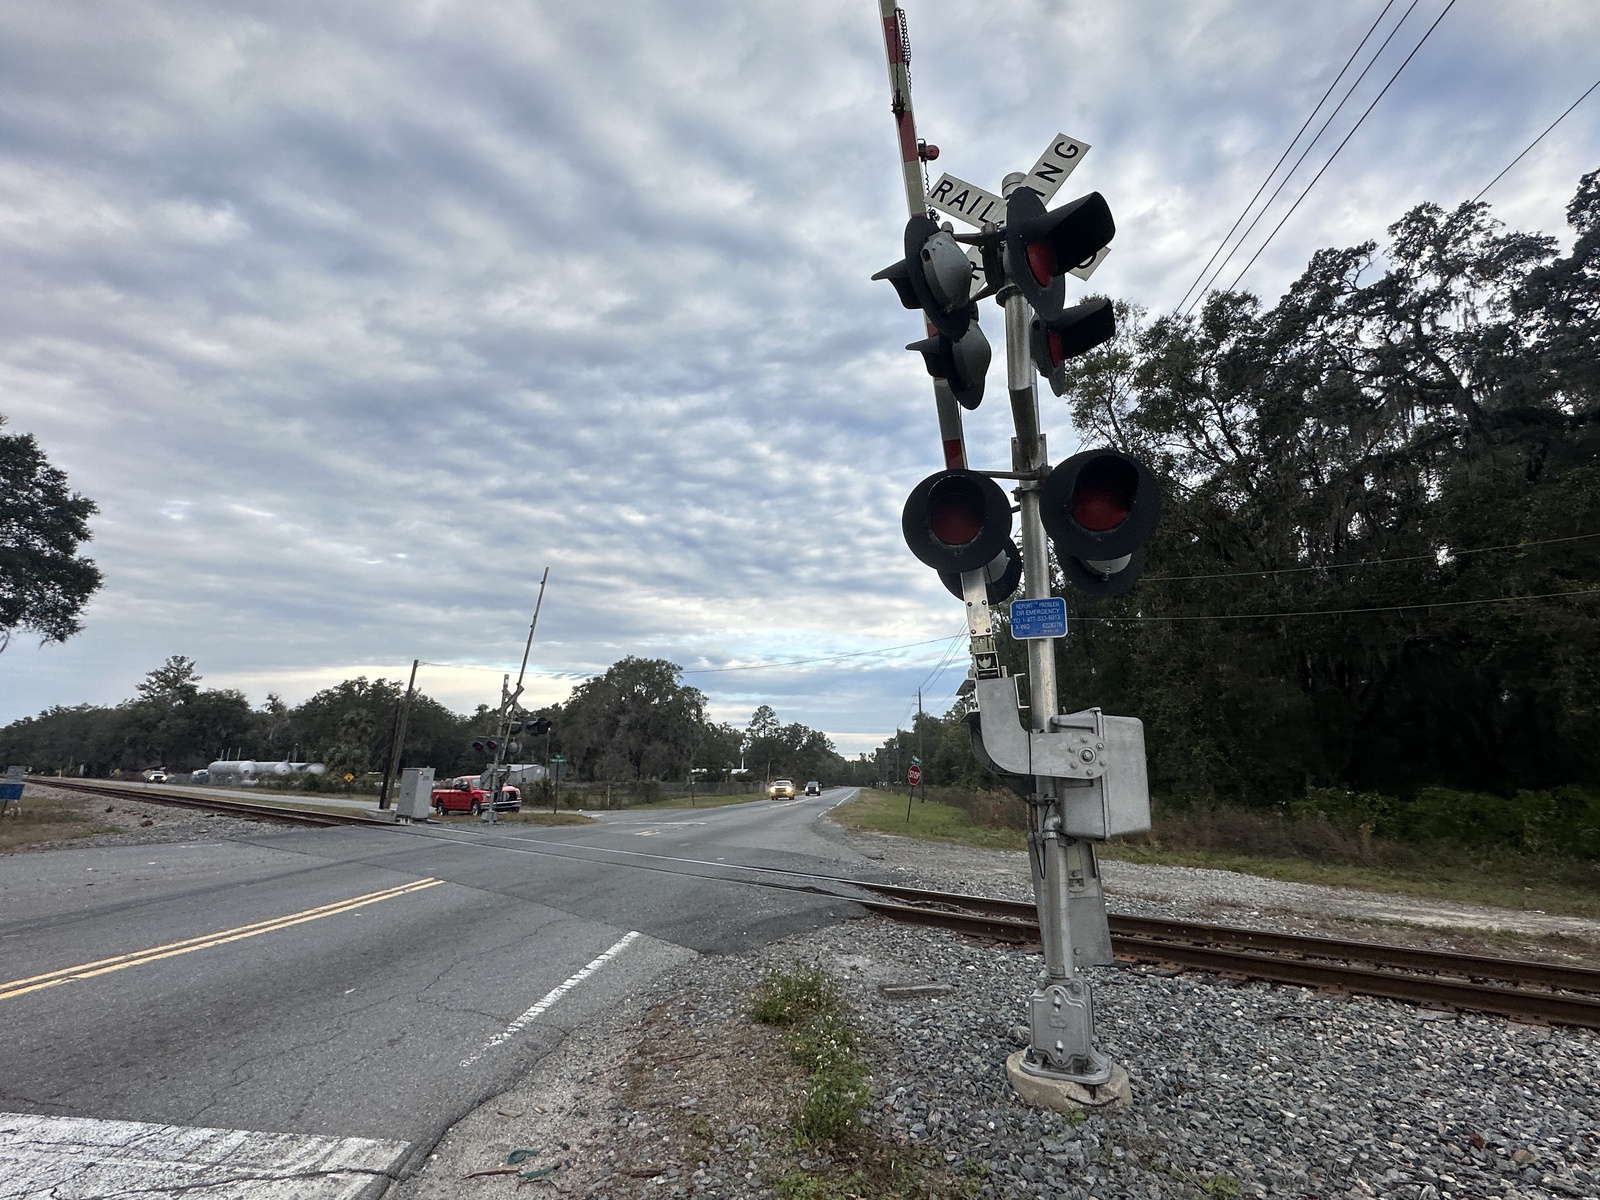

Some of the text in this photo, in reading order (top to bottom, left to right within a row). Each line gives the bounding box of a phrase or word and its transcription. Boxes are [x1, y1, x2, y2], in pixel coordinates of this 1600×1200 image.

[931, 179, 995, 224] RAIL
[1025, 608, 1060, 616] EMERGENCY
[909, 770, 920, 779] STOP
